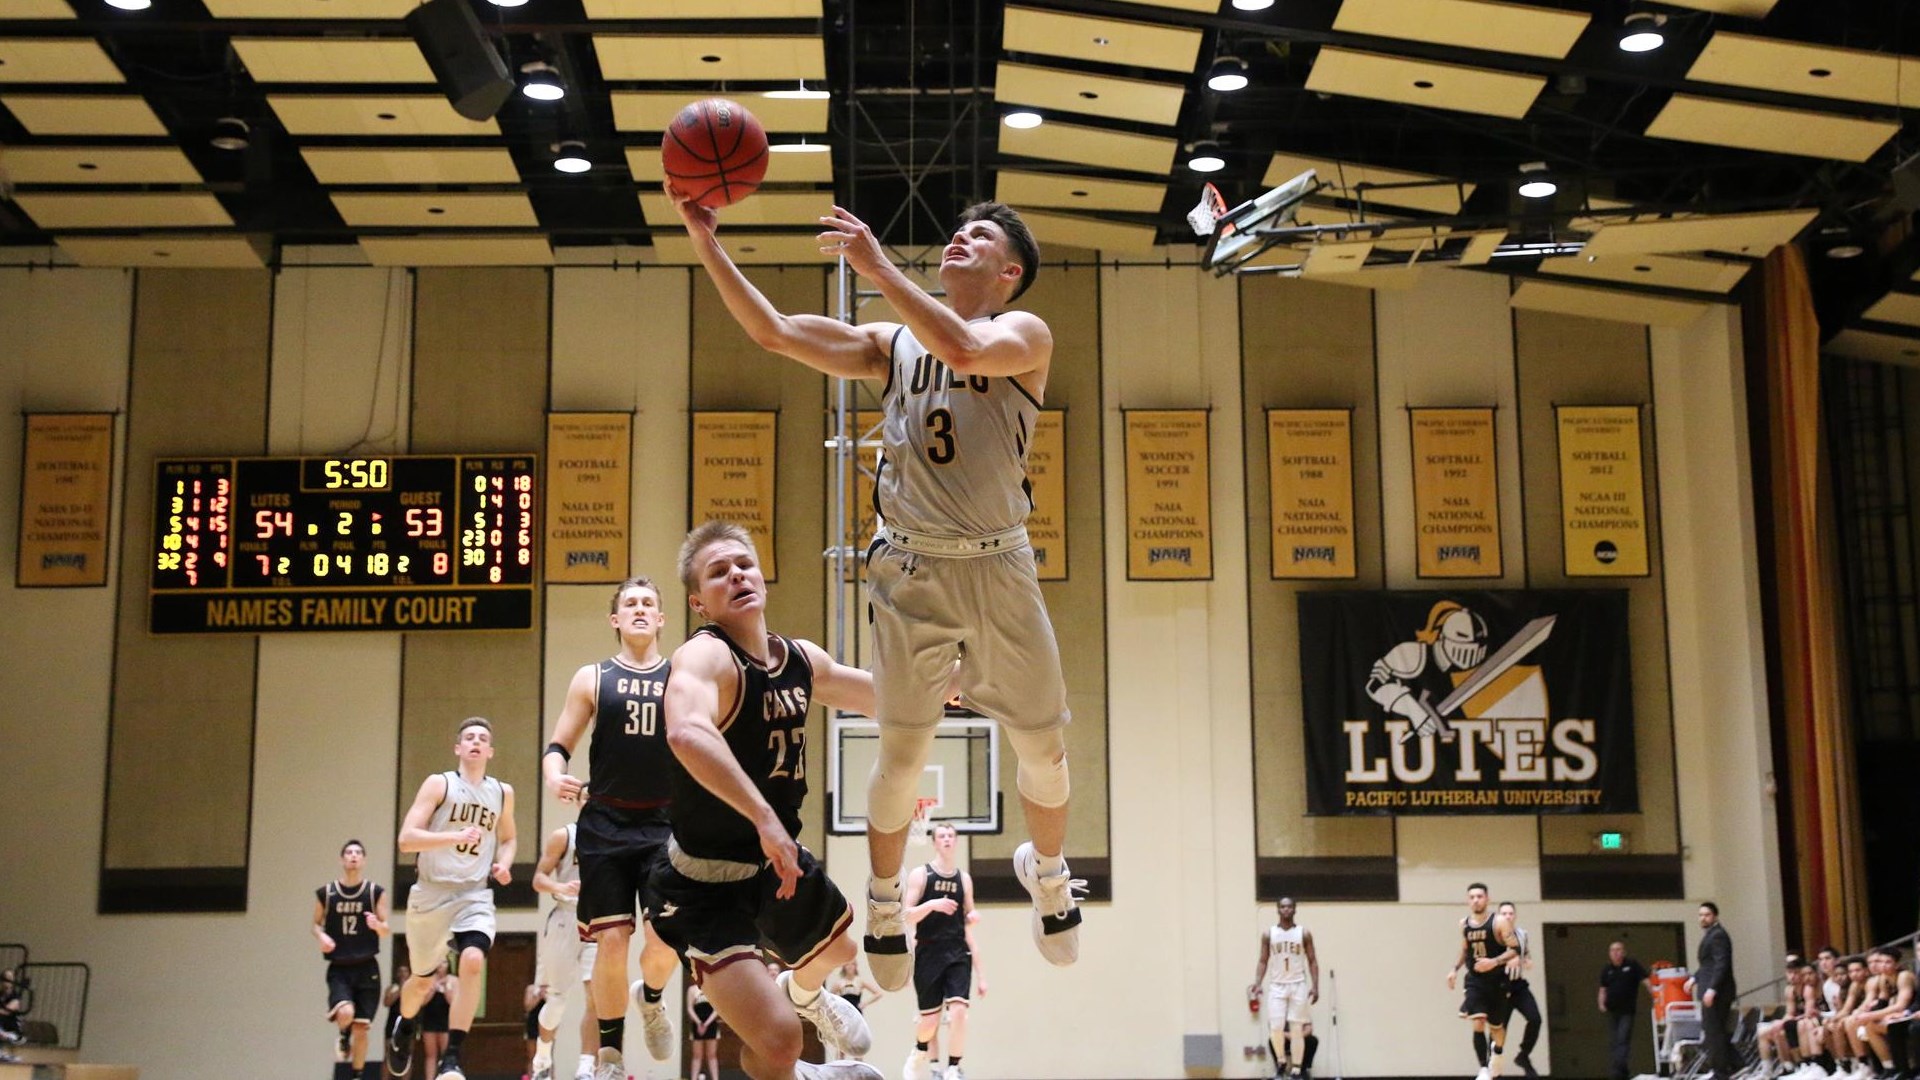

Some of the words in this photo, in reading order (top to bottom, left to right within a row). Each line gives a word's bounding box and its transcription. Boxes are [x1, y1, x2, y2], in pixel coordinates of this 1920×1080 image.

[926, 408, 955, 464] 3
[559, 459, 619, 469] FOOTBALL
[704, 457, 763, 467] FOOTBALL
[1140, 452, 1194, 461] WOMEN'S
[1282, 455, 1338, 465] SOFTBALL
[1426, 455, 1482, 464] SOFTBALL
[1572, 452, 1627, 461] SOFTBALL
[325, 460, 387, 489] 5:50
[1145, 465, 1190, 474] SOCCER
[177, 480, 184, 495] 1
[194, 480, 201, 494] 1
[217, 478, 229, 495] 3
[475, 475, 487, 493] 0
[492, 476, 503, 491] 4
[514, 475, 531, 492] 18
[400, 492, 442, 505] GUEST
[480, 494, 486, 508] 1
[491, 494, 503, 508] 4
[519, 493, 531, 509] 0
[710, 498, 742, 507] NCAA
[1298, 498, 1326, 507] NAIA
[1443, 497, 1470, 506] NAIA
[1579, 492, 1611, 501] NCAA
[172, 496, 183, 514] 3
[193, 498, 201, 512] 1
[210, 496, 228, 513] 12
[561, 502, 589, 511] NAIA
[1154, 502, 1182, 511] NAIA
[1574, 506, 1631, 515] NATIONAL
[406, 508, 442, 536] 53
[474, 512, 486, 529] 5
[497, 513, 503, 527] 1
[520, 511, 530, 528] 3
[558, 516, 617, 525] NATIONAL
[705, 512, 763, 521] NATIONAL
[1139, 516, 1197, 525] NATIONAL
[1283, 512, 1341, 521] NATIONAL
[1428, 511, 1486, 520] NATIONAL
[170, 515, 182, 533] 5
[186, 517, 199, 531] 4
[209, 515, 227, 532] 15
[256, 510, 293, 538] 54
[337, 512, 353, 535] 2
[1277, 525, 1348, 535] CHAMPIONS
[1422, 524, 1492, 534] CHAMPIONS
[1569, 519, 1639, 529] CHAMPIONS
[186, 534, 199, 549] 4
[220, 534, 227, 548] 1
[462, 529, 485, 547] 23
[490, 529, 502, 546] 0
[518, 529, 530, 546] 6
[552, 529, 623, 539] CHAMPIONS
[1134, 529, 1204, 539] CHAMPIONS
[158, 552, 181, 570] 32
[185, 552, 198, 569] 2
[214, 552, 226, 568] 9
[398, 555, 410, 573] 2
[433, 552, 448, 575] 8
[463, 548, 485, 566] 30
[496, 549, 502, 564] 1
[518, 548, 530, 565] 8
[256, 555, 269, 576] 7
[277, 557, 290, 575] 2
[313, 553, 329, 577] 0
[336, 555, 351, 575] 4
[367, 553, 389, 576] 18
[186, 570, 197, 586] 7
[490, 566, 501, 583] 8
[207, 600, 293, 626] NAMES
[301, 598, 387, 625] FAMILY
[394, 596, 477, 624] COURT
[617, 678, 664, 697] CATS
[763, 686, 808, 723] CATS
[625, 700, 657, 736] 30
[1343, 718, 1598, 783] LUTES
[1346, 790, 1407, 807] PACIFIC
[1411, 790, 1499, 806] LUTHERAN
[1503, 789, 1602, 805] UNIVERSITY
[450, 803, 497, 832] LUTES
[934, 880, 957, 893] CATS
[336, 901, 362, 913] CATS
[342, 916, 357, 935] 12
[1284, 957, 1289, 971] 1
